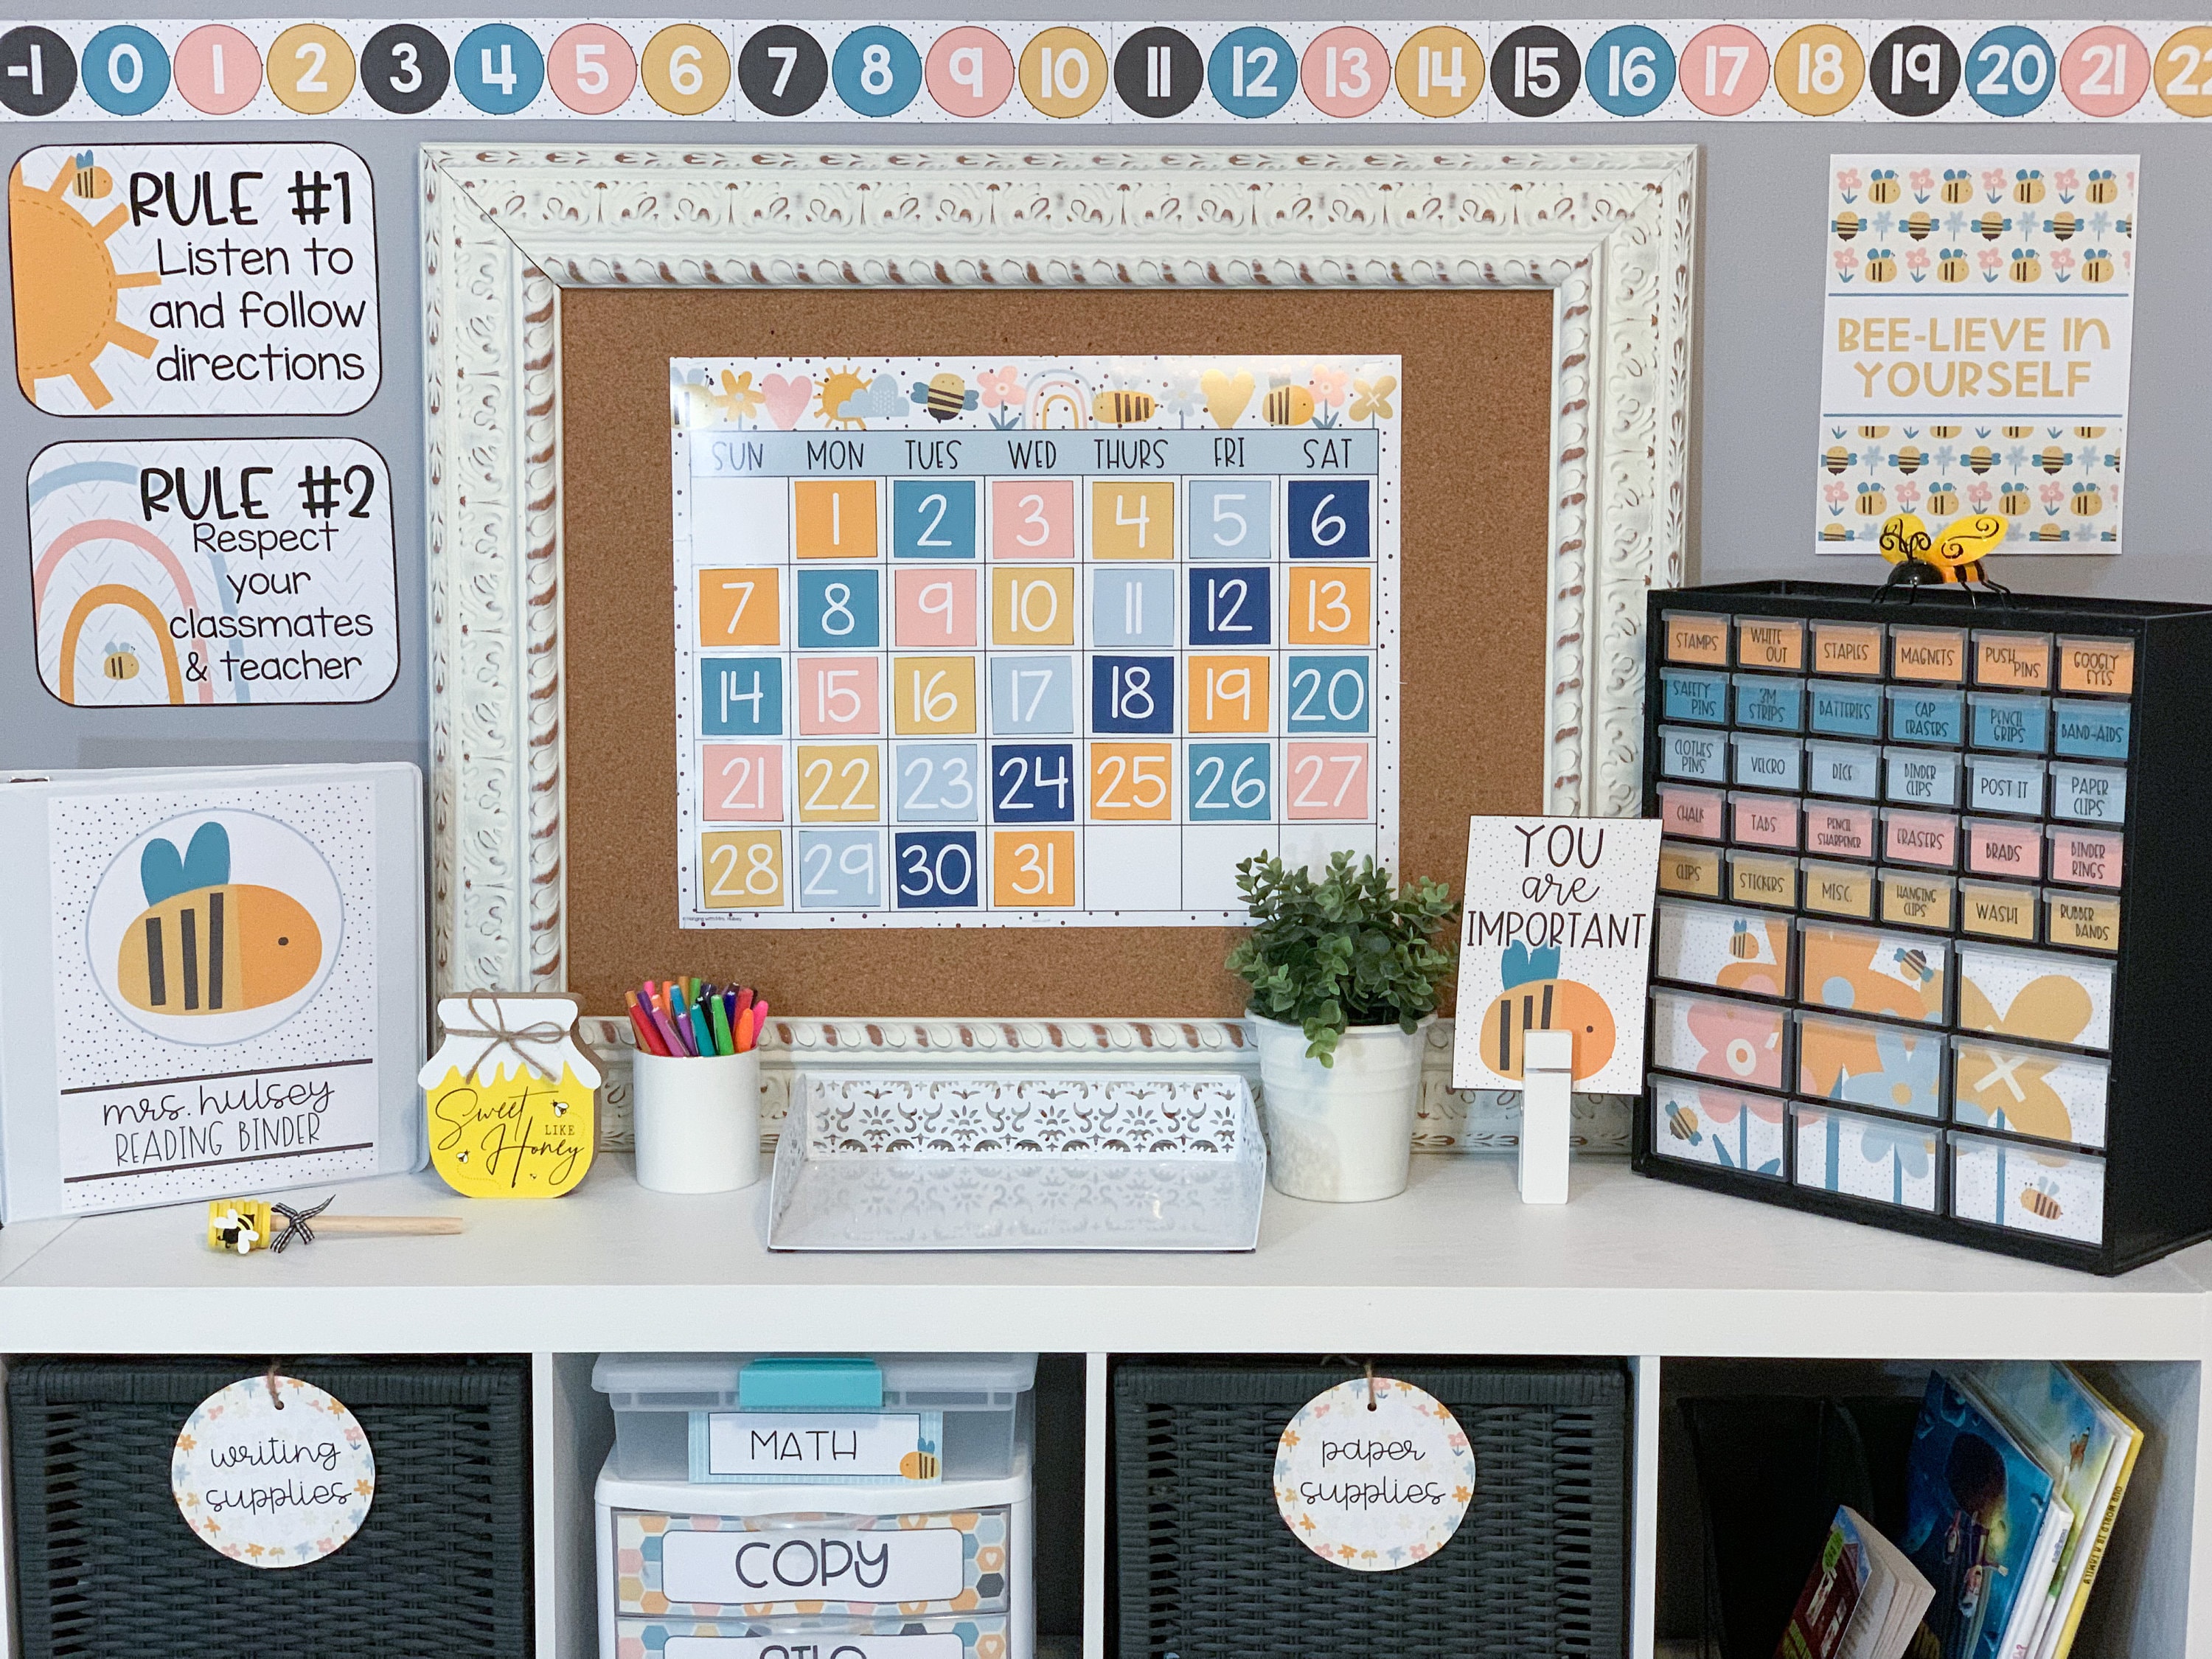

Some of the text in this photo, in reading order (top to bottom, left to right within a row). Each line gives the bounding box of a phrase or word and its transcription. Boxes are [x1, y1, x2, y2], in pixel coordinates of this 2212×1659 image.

[8, 44, 43, 94] -1
[108, 44, 143, 93] 0
[213, 45, 224, 94] 1
[296, 43, 327, 91] 2
[390, 43, 422, 92] 3
[481, 45, 517, 94] 4
[577, 45, 608, 94] 5
[669, 46, 702, 94] 6
[768, 47, 797, 97] 7
[861, 45, 893, 94] 8
[950, 48, 983, 97] 9
[1042, 48, 1088, 98] 10
[1147, 46, 1171, 97] 11
[1233, 46, 1277, 97] 12
[1326, 47, 1371, 97] 13
[1419, 47, 1466, 97] 14
[1514, 46, 1560, 98] 15
[1608, 46, 1657, 96] 16
[1705, 46, 1749, 96] 17
[1798, 44, 1843, 95] 18
[1891, 44, 1940, 94] 19
[1977, 45, 2047, 94] 20
[2079, 45, 2126, 94] 21
[130, 171, 350, 226] RULE #1
[158, 237, 353, 276] Listen to
[150, 291, 366, 328] and follow
[1839, 318, 2045, 352] BEE-LIEVE
[157, 344, 364, 381] directions
[1854, 361, 2090, 397] YOURSELF
[712, 437, 1352, 472] SUN MON TUES WED THURS FRI SAT
[141, 465, 374, 521] RULE #2
[833, 493, 1346, 548] 1 2 3 4 5 6
[193, 521, 338, 560] Respect
[226, 572, 310, 604] your
[723, 579, 1351, 635] 7 8 9 10 11 12 13
[170, 607, 373, 639] classmates
[1676, 633, 1719, 650] STAMPS
[1750, 627, 1782, 644] WHITE
[1767, 647, 1787, 663] OUT
[1824, 643, 1869, 661] STAPLES
[1902, 647, 1955, 666] MAGNETS
[1986, 647, 2014, 664] PUSH
[2074, 652, 2118, 669] GOOGLY
[187, 650, 362, 681] & teacher
[2014, 661, 2041, 678] PINS
[2087, 670, 2113, 686] EYES
[721, 666, 1364, 723] 14 15 16 17 18 19 20
[1674, 681, 1711, 698] SAFETY
[1692, 700, 1717, 716] PINS
[1749, 703, 1785, 722] STRIPS
[1820, 700, 1872, 720] BATTERIES
[1916, 702, 1935, 717] CAP
[1991, 709, 2023, 727] PENCIL
[1906, 720, 1950, 737] ERASERS
[1994, 726, 2025, 742] GRIPS
[2062, 724, 2124, 742] BAND-AIDS
[1675, 739, 1714, 758] CLOTHES
[1682, 757, 1706, 773] PINS
[1751, 757, 1785, 774] VELCRO
[1833, 763, 1852, 780] DICE
[1905, 763, 1936, 779] BINDER
[722, 756, 1362, 810] 21 22 23 24 25 26 27
[1907, 781, 1933, 796] CLIPS
[1982, 778, 2028, 798] POST IT
[2072, 776, 2108, 795] PAPER
[1677, 804, 1704, 823] CHALK
[2074, 798, 2105, 816] CLIPS
[1752, 814, 1778, 832] TABS
[1827, 817, 1851, 831] PENCIL
[1514, 824, 1604, 869] YOU
[1818, 834, 1861, 848] SHARPENER
[1897, 829, 1944, 849] ERASERS
[1986, 843, 2022, 862] BRADS
[2071, 842, 2105, 859] BINDER
[710, 843, 1054, 896] 28 29 30 31
[1677, 864, 1702, 881] CLIPS
[2072, 863, 2105, 879] RINGS
[1523, 874, 1600, 905] are
[1740, 872, 1784, 893] STICKERS
[1823, 883, 1852, 902] MISC.
[1897, 885, 1936, 903] HANGING
[1904, 902, 1927, 917] CLIPS
[1976, 902, 2018, 924] WASHI
[2061, 904, 2094, 922] RUBBER
[1467, 911, 1646, 948] IMPORTANT
[2076, 923, 2110, 941] BANDS
[104, 1079, 335, 1126] mrs. hulsey
[436, 1086, 559, 1150] Sweet
[116, 1113, 320, 1166] READING BINDER
[546, 1125, 574, 1135] LIKE
[481, 1116, 584, 1188] Honey
[211, 1437, 341, 1470] writing
[751, 1430, 856, 1461] MATH
[1323, 1439, 1425, 1467] paper
[206, 1479, 352, 1515] supplies
[1301, 1476, 1446, 1510] supplies
[736, 1538, 888, 1588] COPY
